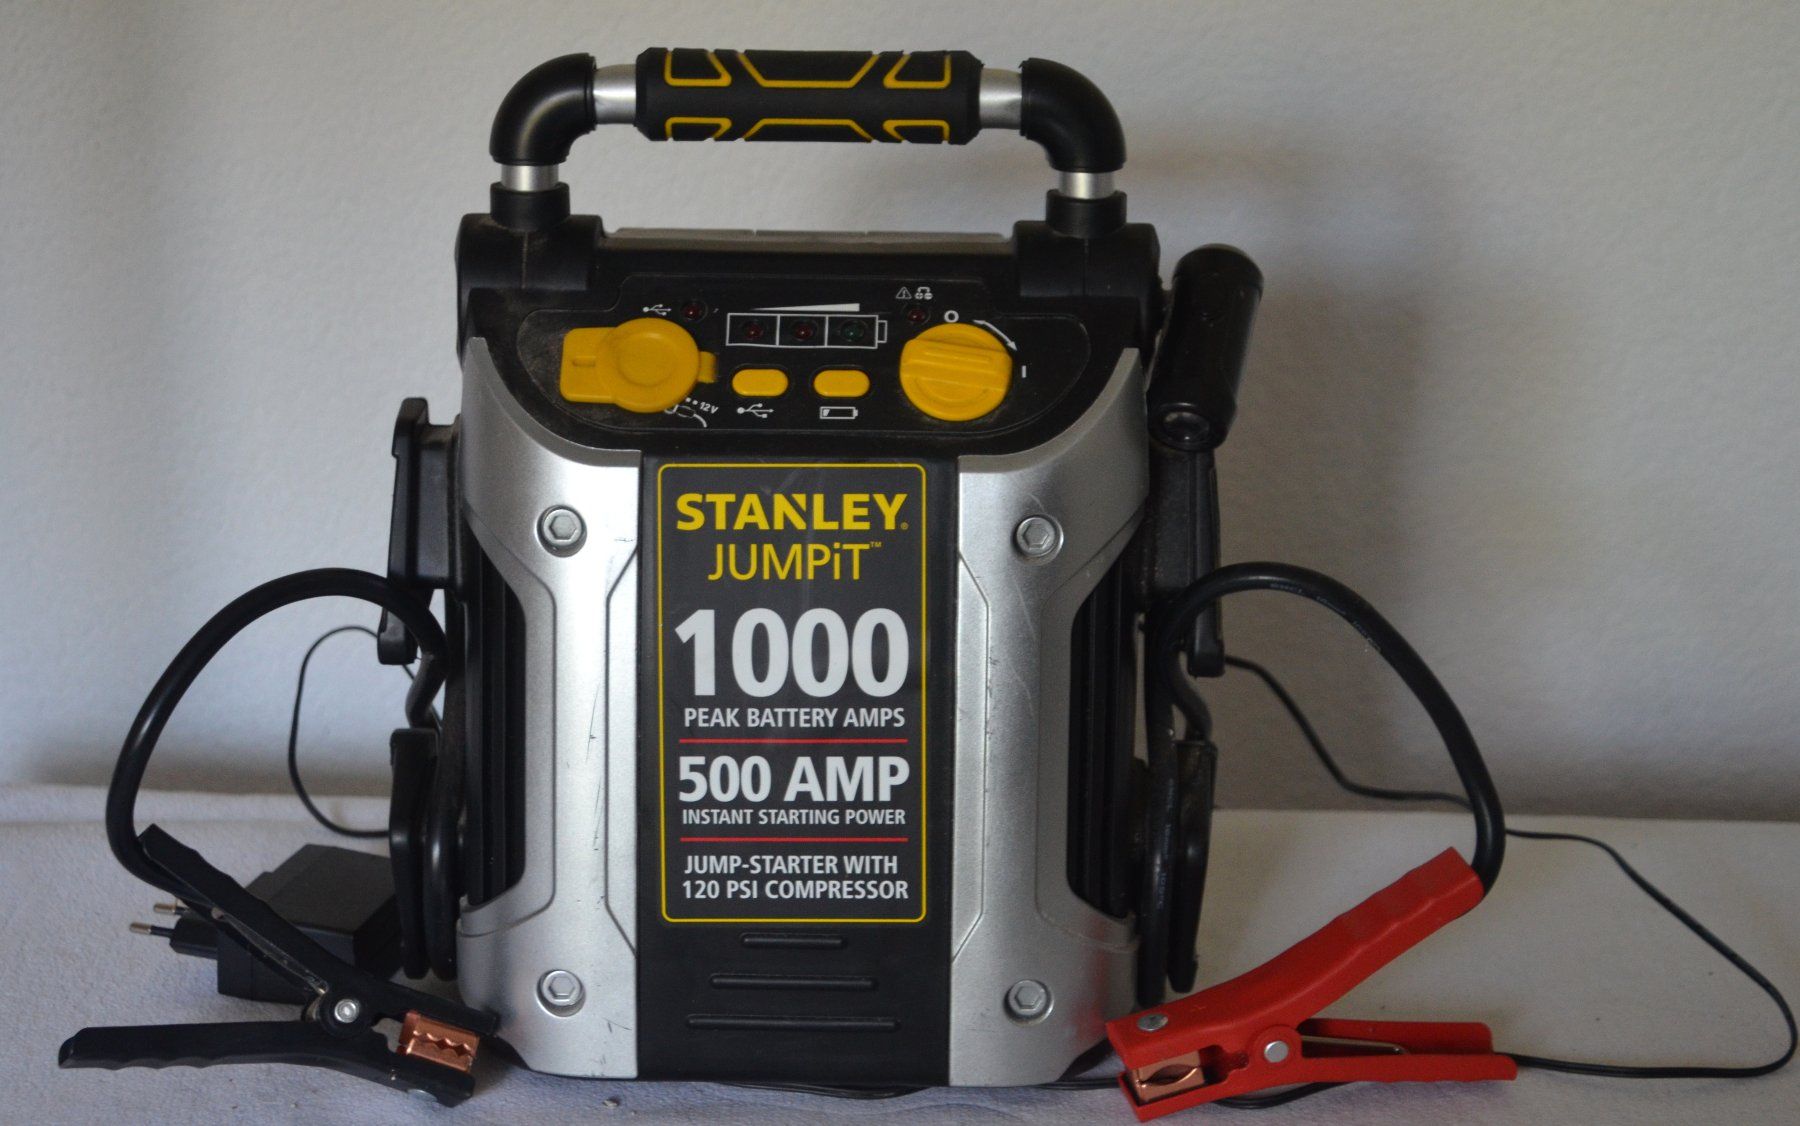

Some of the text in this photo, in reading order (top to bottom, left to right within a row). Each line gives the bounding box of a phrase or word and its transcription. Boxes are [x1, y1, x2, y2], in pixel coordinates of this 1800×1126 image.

[699, 401, 719, 414] 12V
[676, 493, 908, 531] STANLEY
[675, 608, 909, 697] 1000
[685, 708, 905, 727] PEAK BATTERY AMPS
[679, 756, 909, 802] 500 AMP
[683, 809, 905, 824] INSTANT STARTING POWER
[684, 855, 897, 874] JUMP-STARTER WITH
[683, 880, 908, 899] 120 PSI COMPRESSOR
